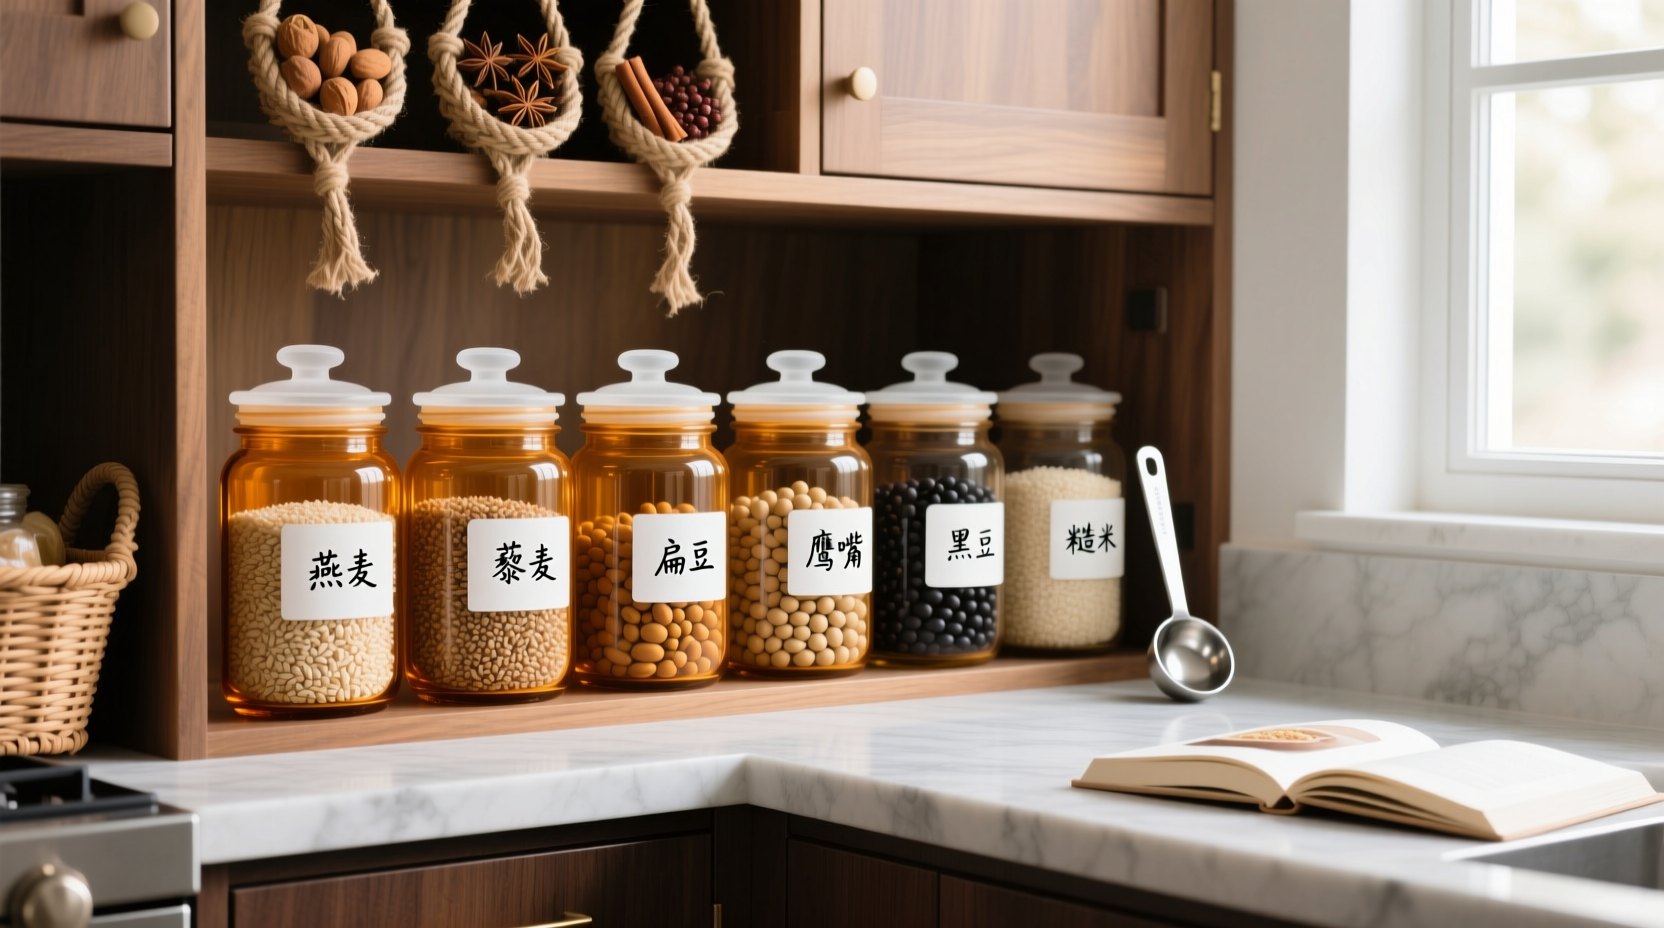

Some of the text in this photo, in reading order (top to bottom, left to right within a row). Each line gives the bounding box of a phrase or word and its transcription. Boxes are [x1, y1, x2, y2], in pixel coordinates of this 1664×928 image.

[654, 537, 715, 577] 扁豆
[805, 529, 863, 572] 鹰嘴
[947, 527, 995, 562] 黑豆
[1066, 521, 1117, 555] 糙米
[308, 547, 377, 591] 燕麦
